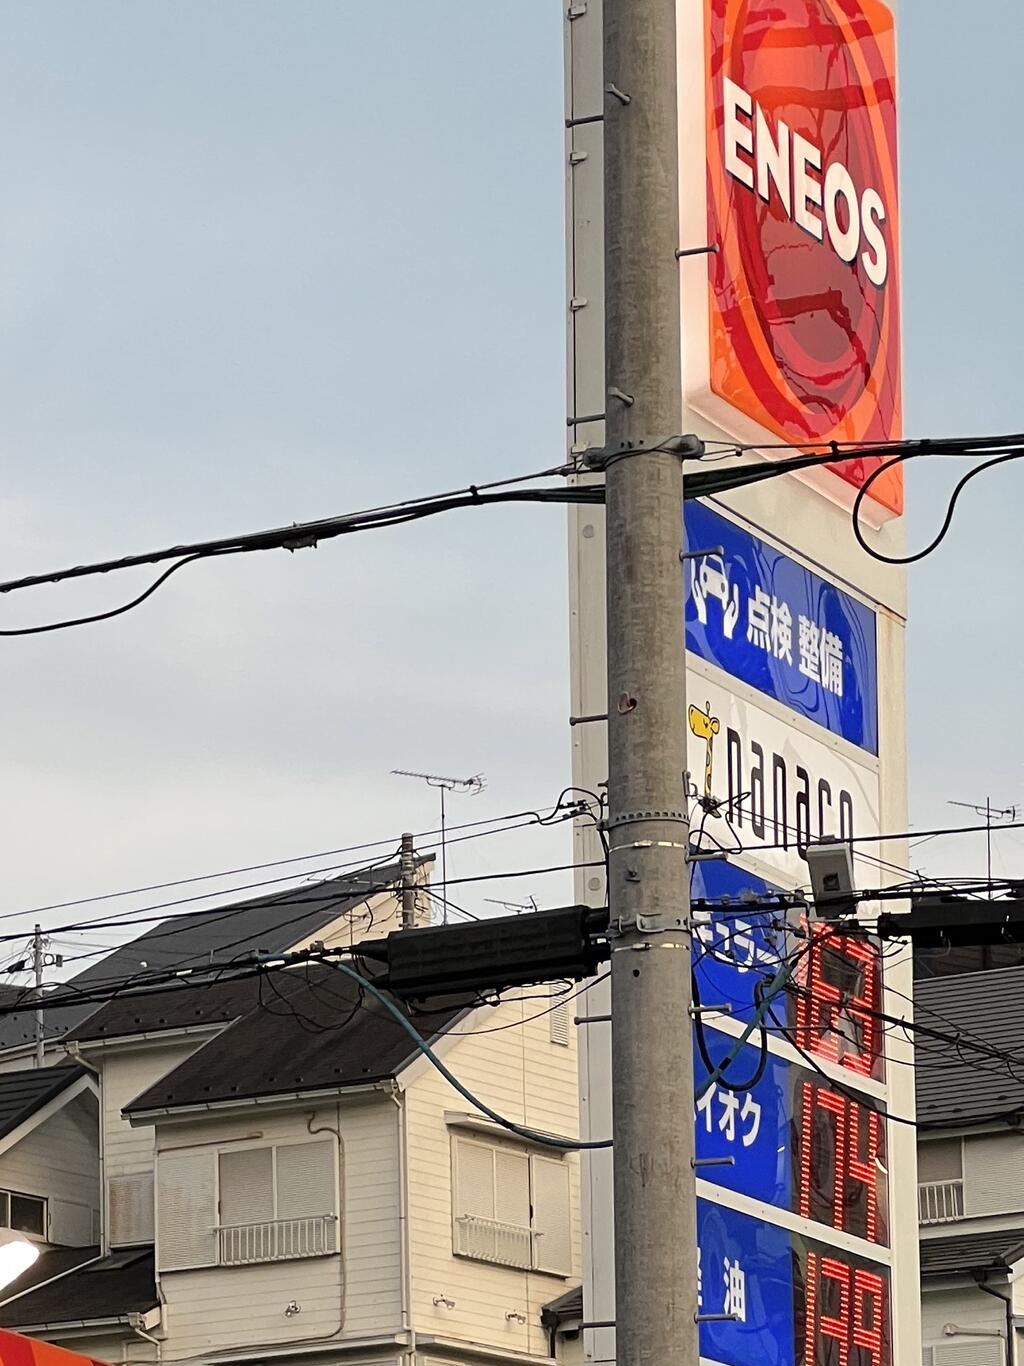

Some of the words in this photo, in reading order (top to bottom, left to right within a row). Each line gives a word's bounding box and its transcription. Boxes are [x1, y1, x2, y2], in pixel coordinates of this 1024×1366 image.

[723, 76, 888, 288] ENEOS
[694, 1082, 762, 1147] イオク
[800, 1082, 878, 1243] 174
